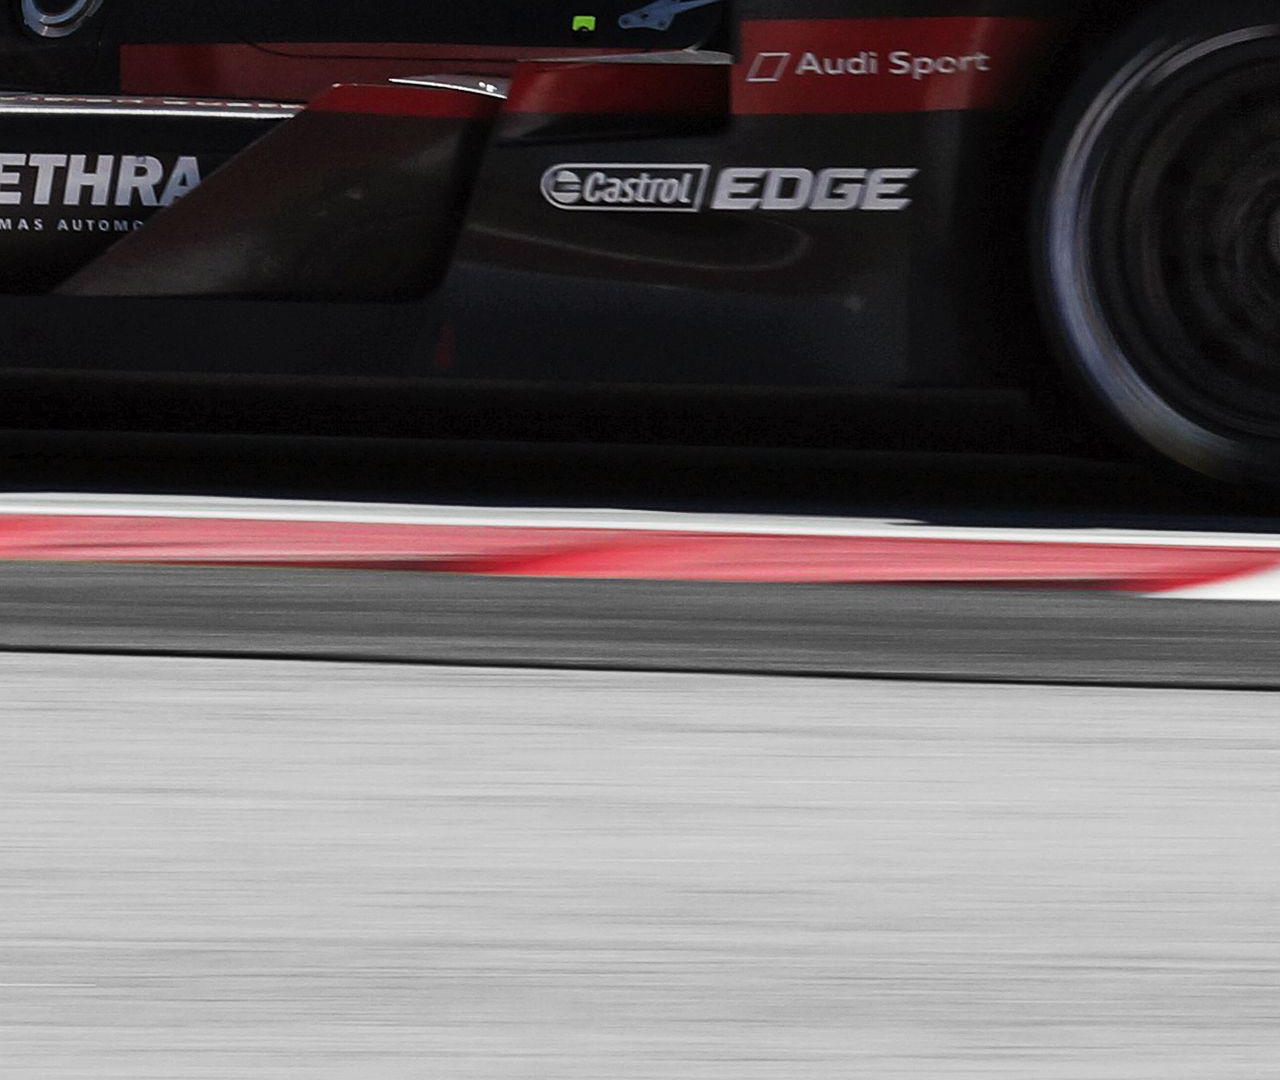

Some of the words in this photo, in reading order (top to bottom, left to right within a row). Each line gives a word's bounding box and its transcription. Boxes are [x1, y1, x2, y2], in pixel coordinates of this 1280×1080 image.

[795, 52, 879, 76] Audi
[888, 51, 992, 80] Sport
[582, 170, 692, 205] Castrol
[711, 167, 919, 210] EDGE
